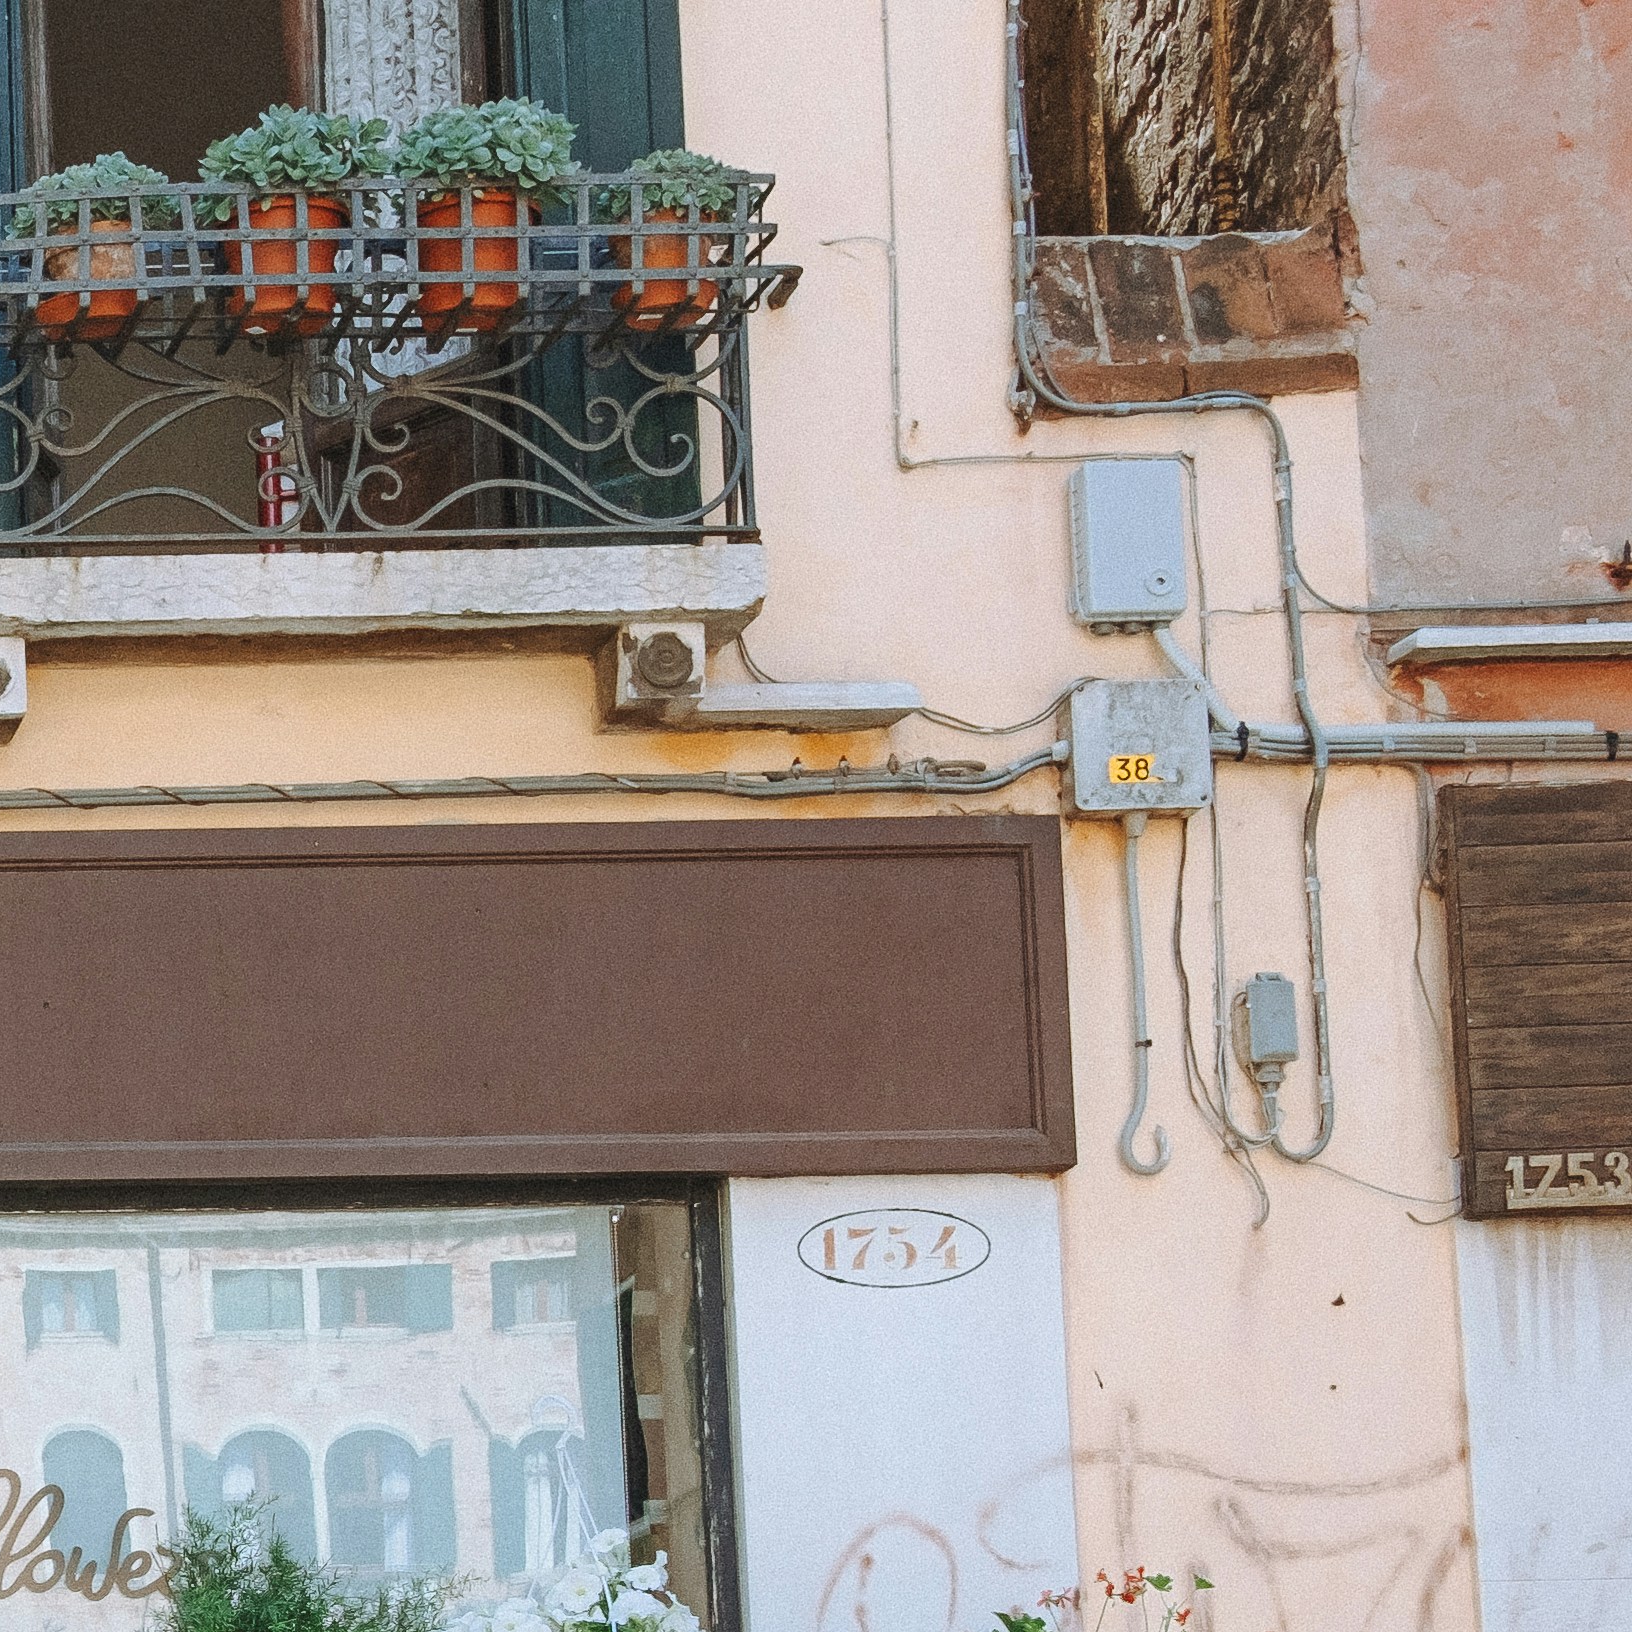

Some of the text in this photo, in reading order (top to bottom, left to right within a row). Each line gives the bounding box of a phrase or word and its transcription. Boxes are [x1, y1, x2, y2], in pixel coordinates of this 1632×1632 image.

[1116, 758, 1149, 781] 38
[1504, 1151, 1632, 1199] 1753
[823, 1225, 962, 1270] 1754
